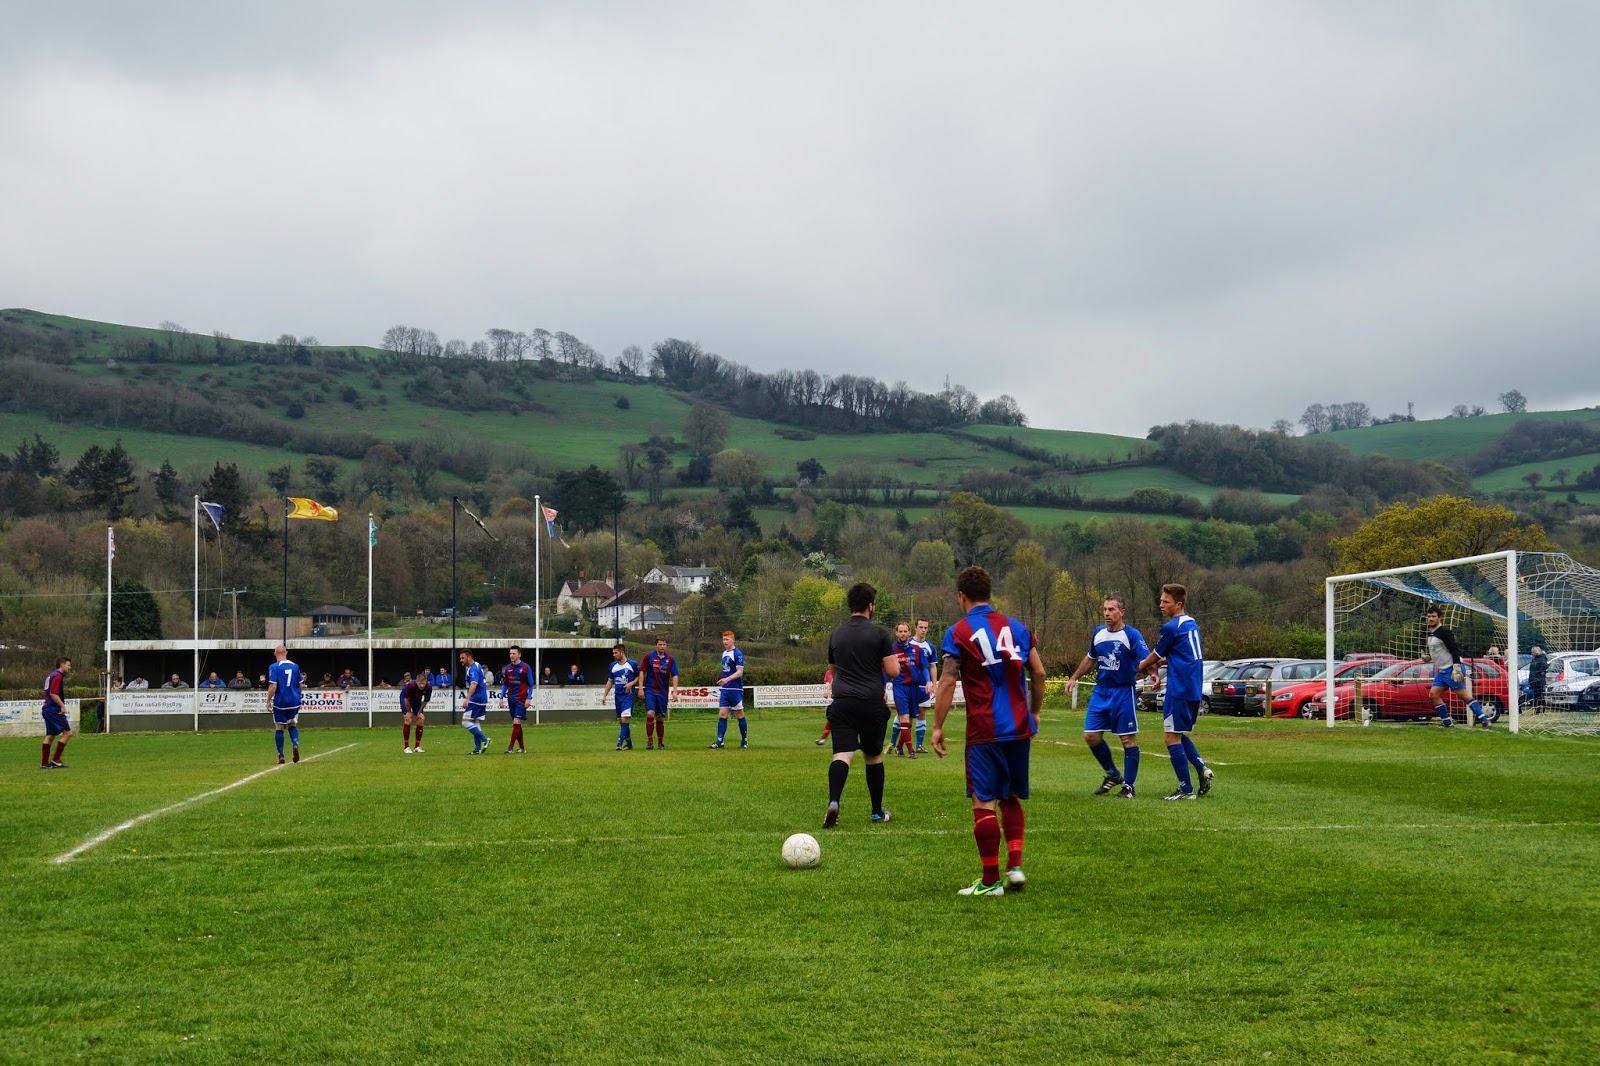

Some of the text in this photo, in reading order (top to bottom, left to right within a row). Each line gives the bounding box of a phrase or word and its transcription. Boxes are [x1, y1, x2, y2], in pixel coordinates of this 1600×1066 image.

[969, 626, 1021, 666] 14
[1188, 630, 1202, 660] 11
[284, 669, 293, 687] 7
